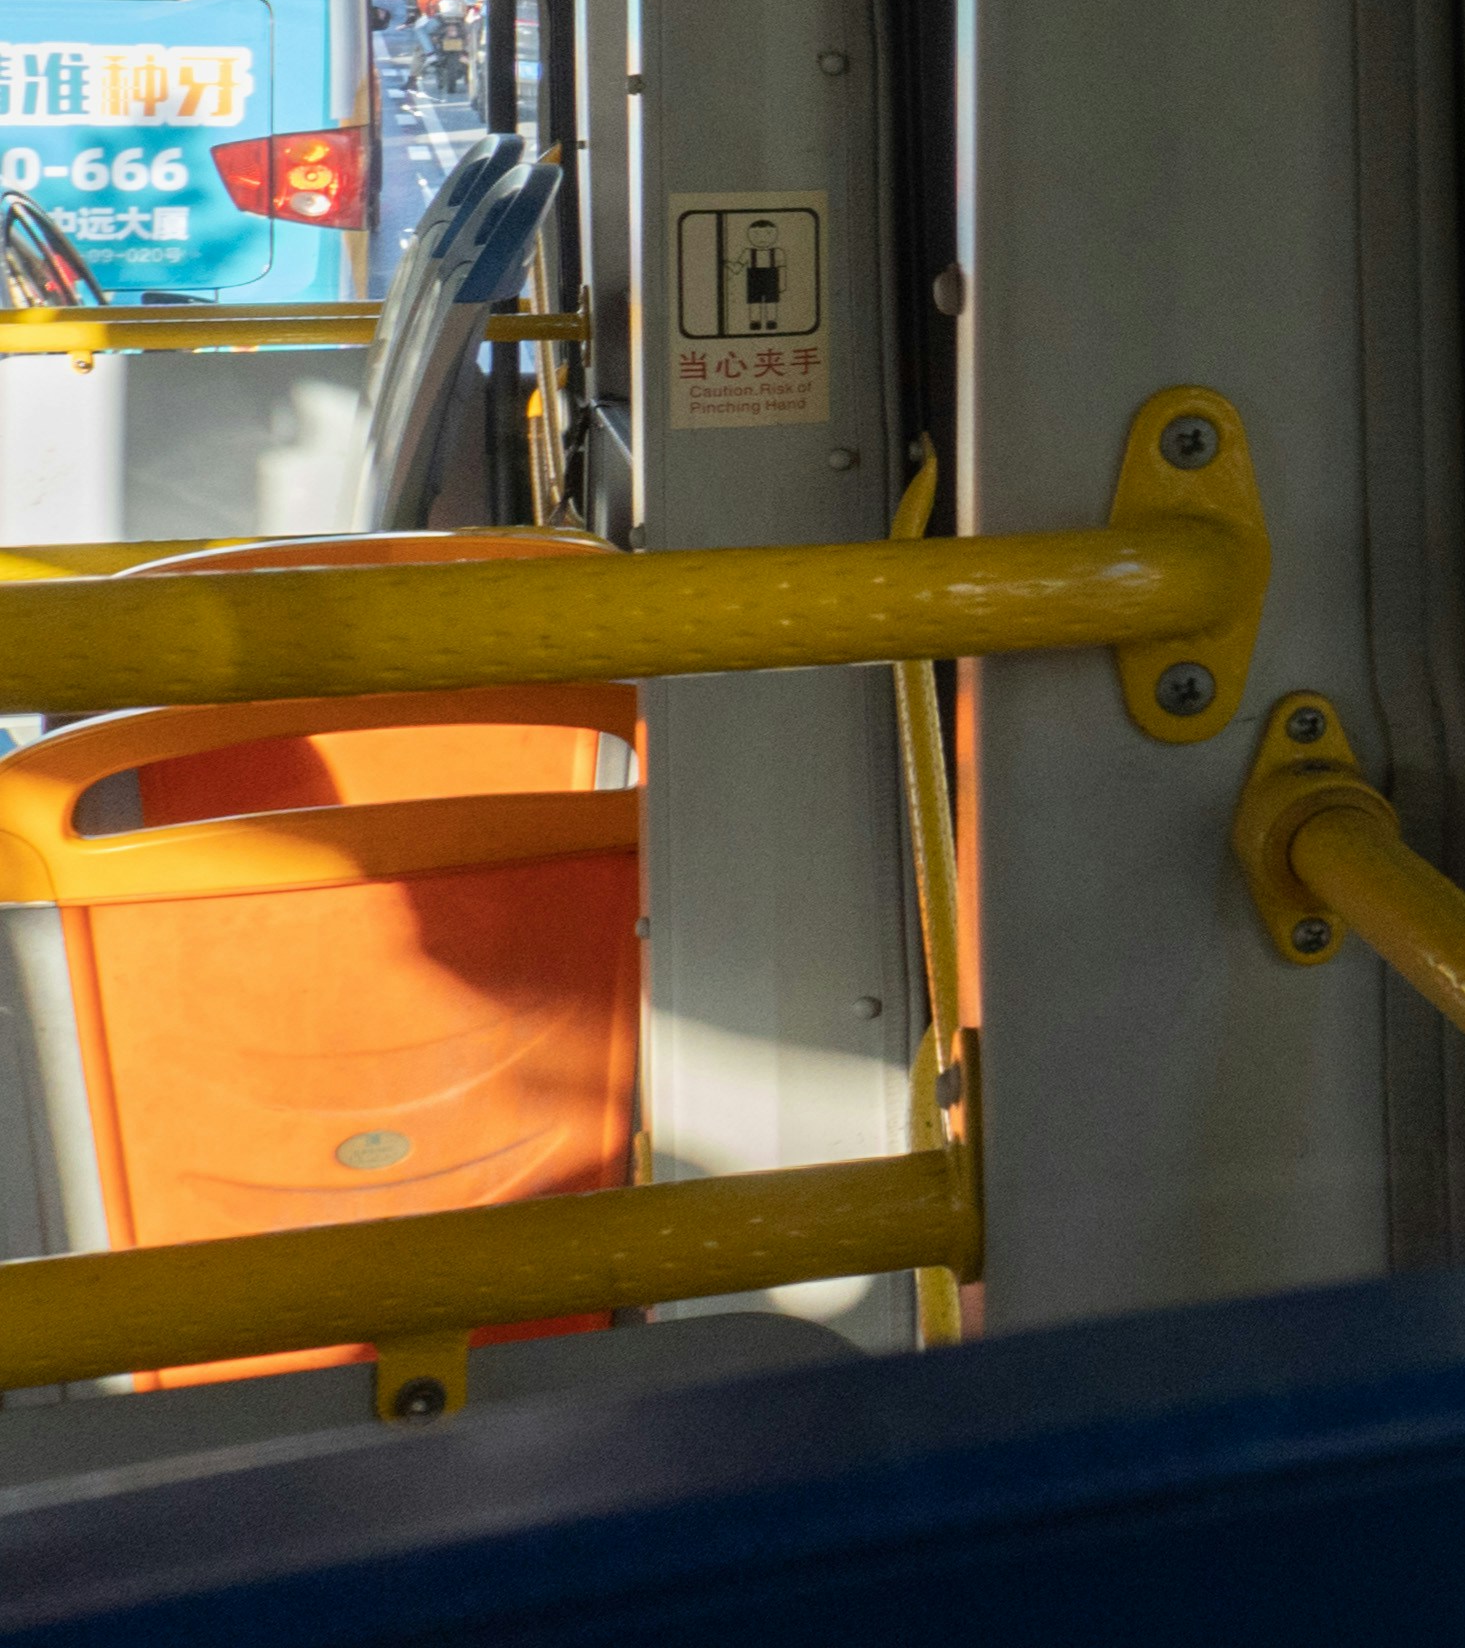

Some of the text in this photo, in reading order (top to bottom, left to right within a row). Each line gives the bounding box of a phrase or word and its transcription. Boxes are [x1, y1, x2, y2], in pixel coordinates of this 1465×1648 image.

[0, 52, 241, 117] 准种牙
[679, 348, 821, 380] 当心夹手
[689, 399, 806, 415] Pinching Hand
